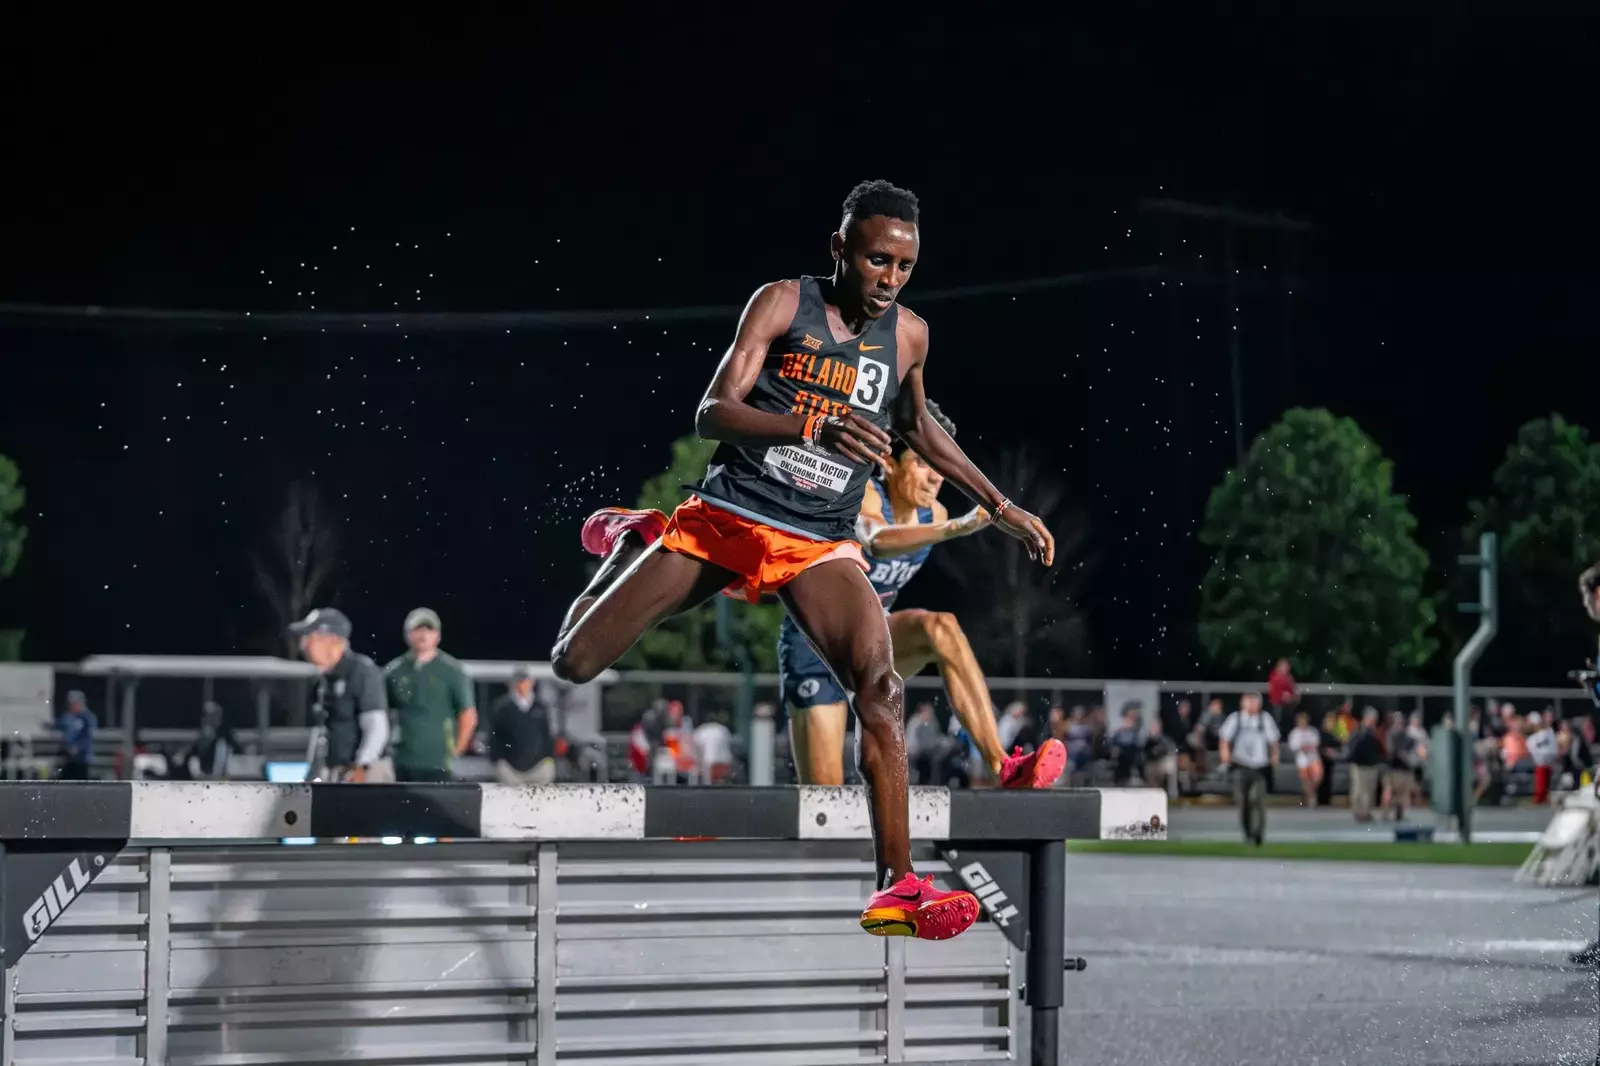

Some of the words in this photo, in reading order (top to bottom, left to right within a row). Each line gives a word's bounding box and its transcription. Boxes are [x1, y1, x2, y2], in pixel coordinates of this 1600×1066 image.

[779, 353, 857, 395] OKLAHO
[857, 363, 882, 405] 3
[773, 446, 818, 471] SHITSAMA,
[819, 462, 849, 481] VICTOR
[780, 460, 816, 481] OKLAHOMA
[816, 475, 834, 488] STATE
[23, 858, 91, 941] GILL
[961, 861, 1020, 927] GILL
